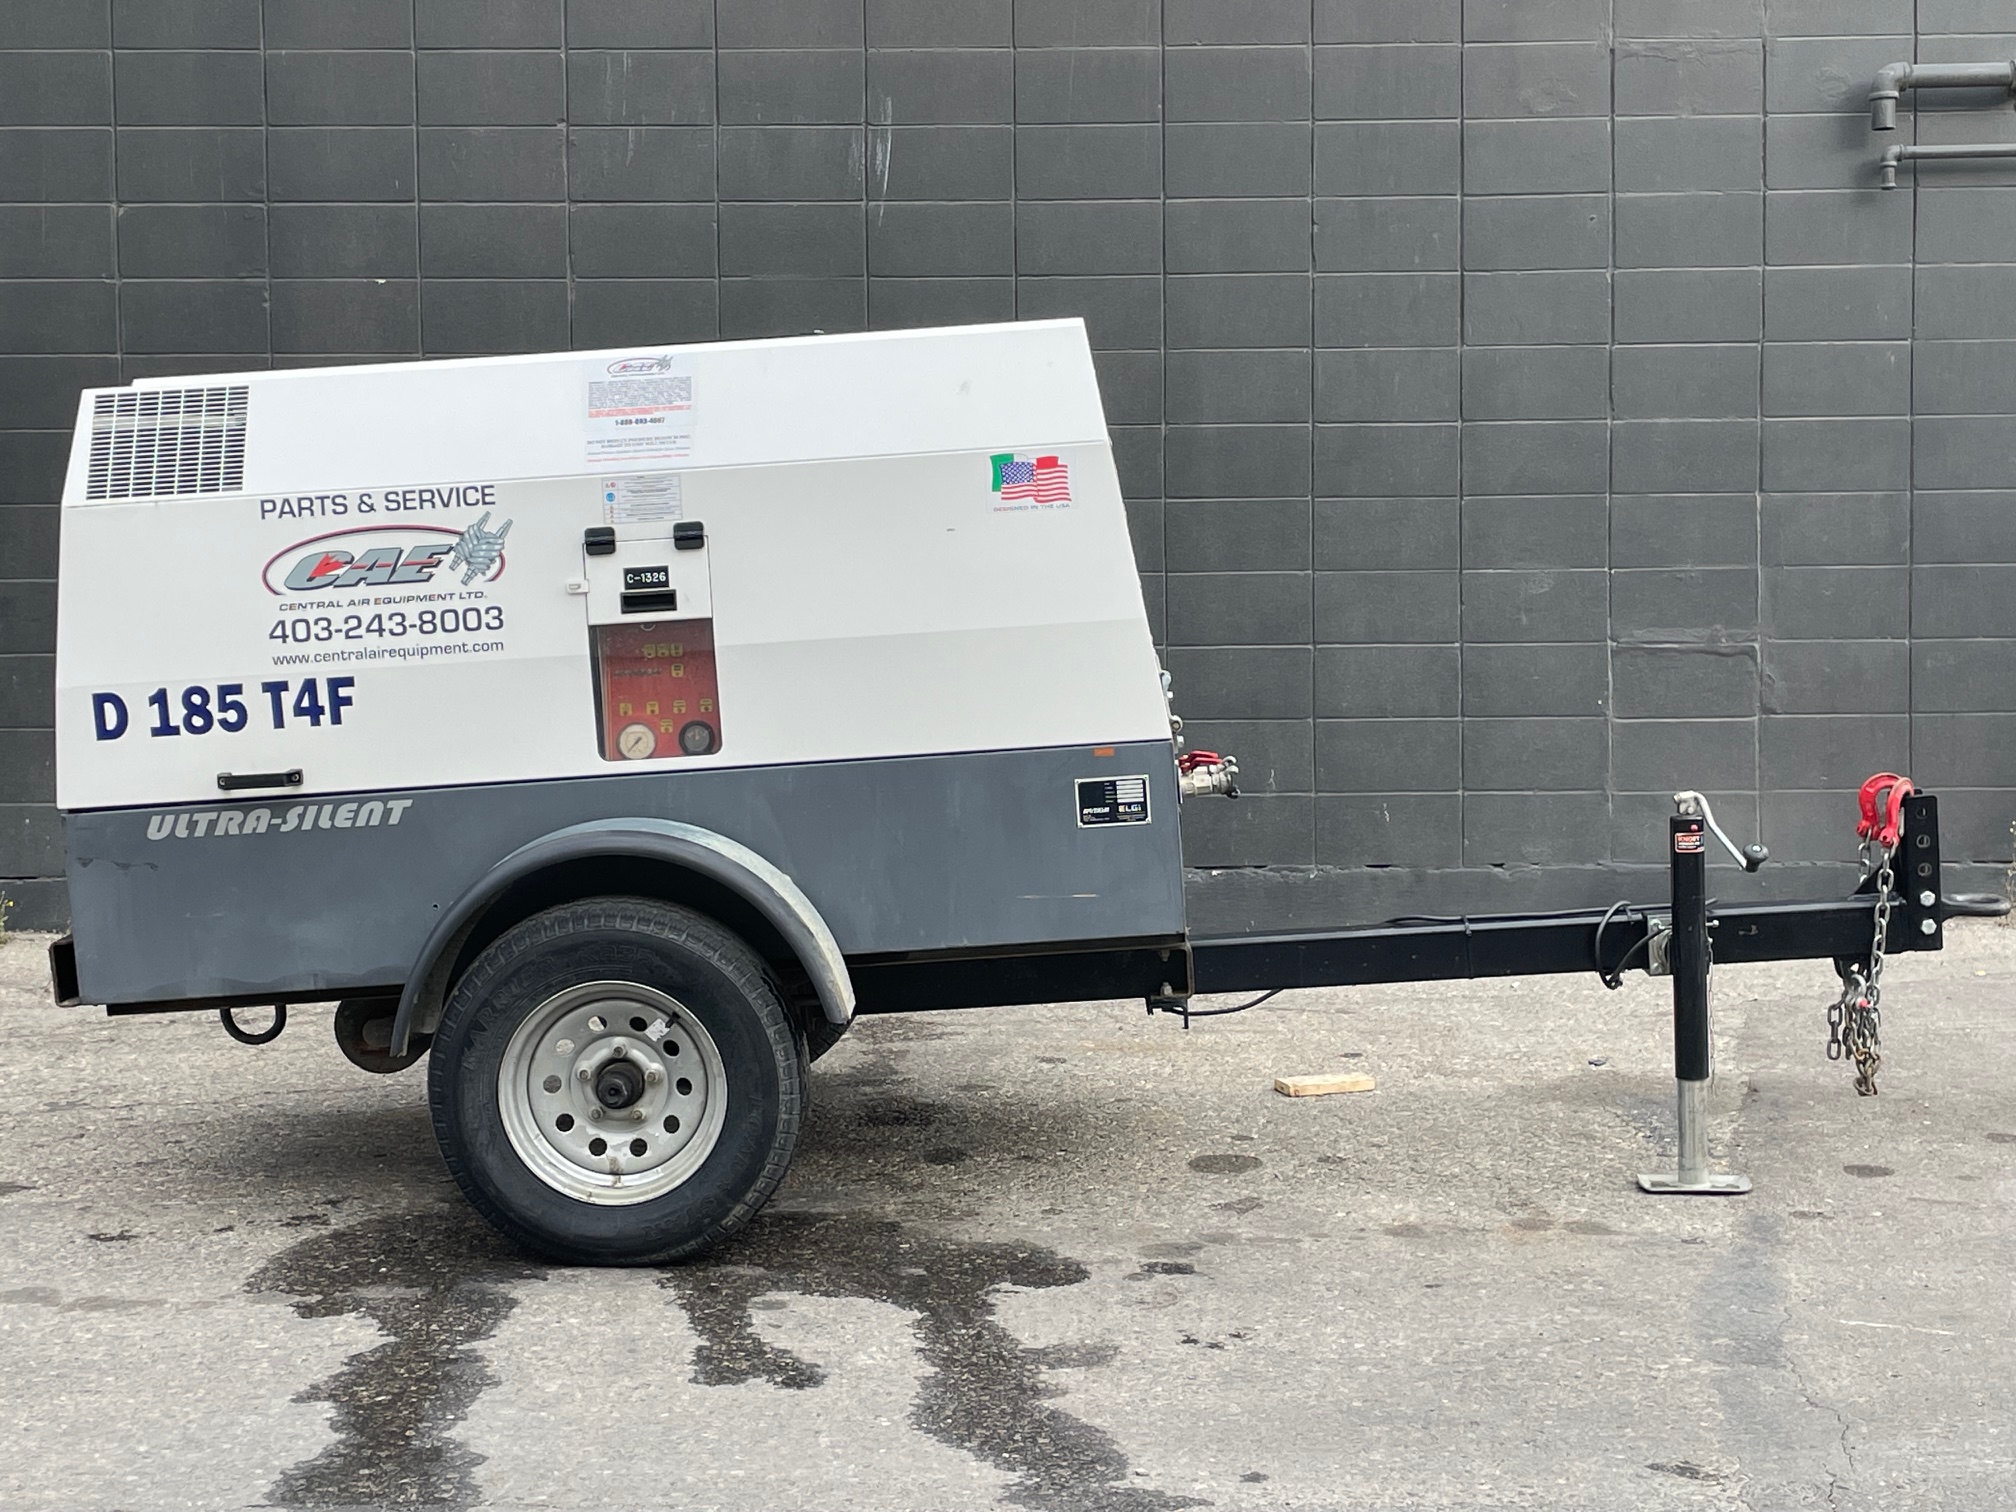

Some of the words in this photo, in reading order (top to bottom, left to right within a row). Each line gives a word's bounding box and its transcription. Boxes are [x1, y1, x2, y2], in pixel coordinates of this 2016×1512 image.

[260, 493, 348, 520] PARTS
[357, 493, 377, 514] &
[384, 485, 496, 511] SERVICE
[283, 544, 454, 592] CAE
[626, 571, 667, 584] C-1326
[279, 600, 344, 611] CENTRAL
[347, 597, 371, 608] AIR
[373, 592, 456, 606] EQUIPMENT
[268, 605, 504, 644] 403-243-8003
[272, 641, 504, 666] www.centralairequipment.com
[91, 692, 129, 741] D
[148, 683, 248, 737] 185
[261, 676, 356, 730] T4F
[146, 799, 413, 841] ULTRA-SILENT
